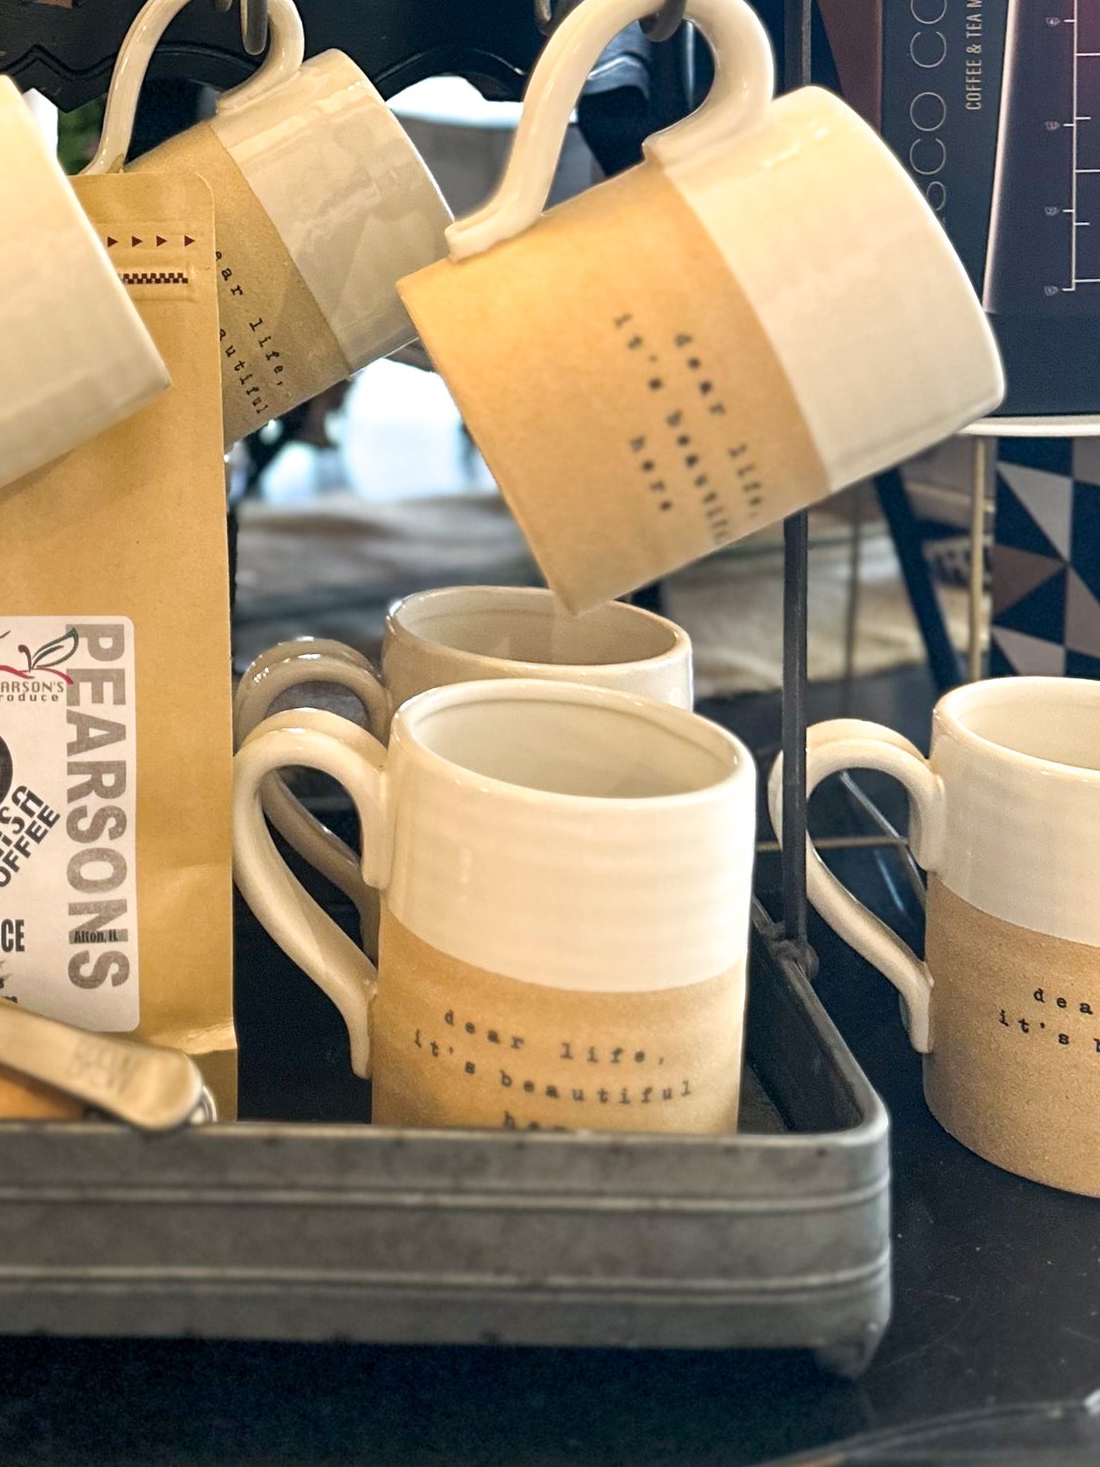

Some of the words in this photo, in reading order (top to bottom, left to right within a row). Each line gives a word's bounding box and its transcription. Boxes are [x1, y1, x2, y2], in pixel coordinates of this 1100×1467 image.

[965, 13, 983, 39] TEA
[965, 43, 983, 55] &
[965, 59, 983, 111] COFFEE
[215, 251, 243, 297] ear
[249, 318, 284, 386] life,
[66, 623, 130, 990] PEARSONS
[444, 1009, 524, 1050] dear
[560, 1042, 665, 1066] life,
[999, 1009, 1070, 1045] it's
[499, 1070, 692, 1105] beautiful
